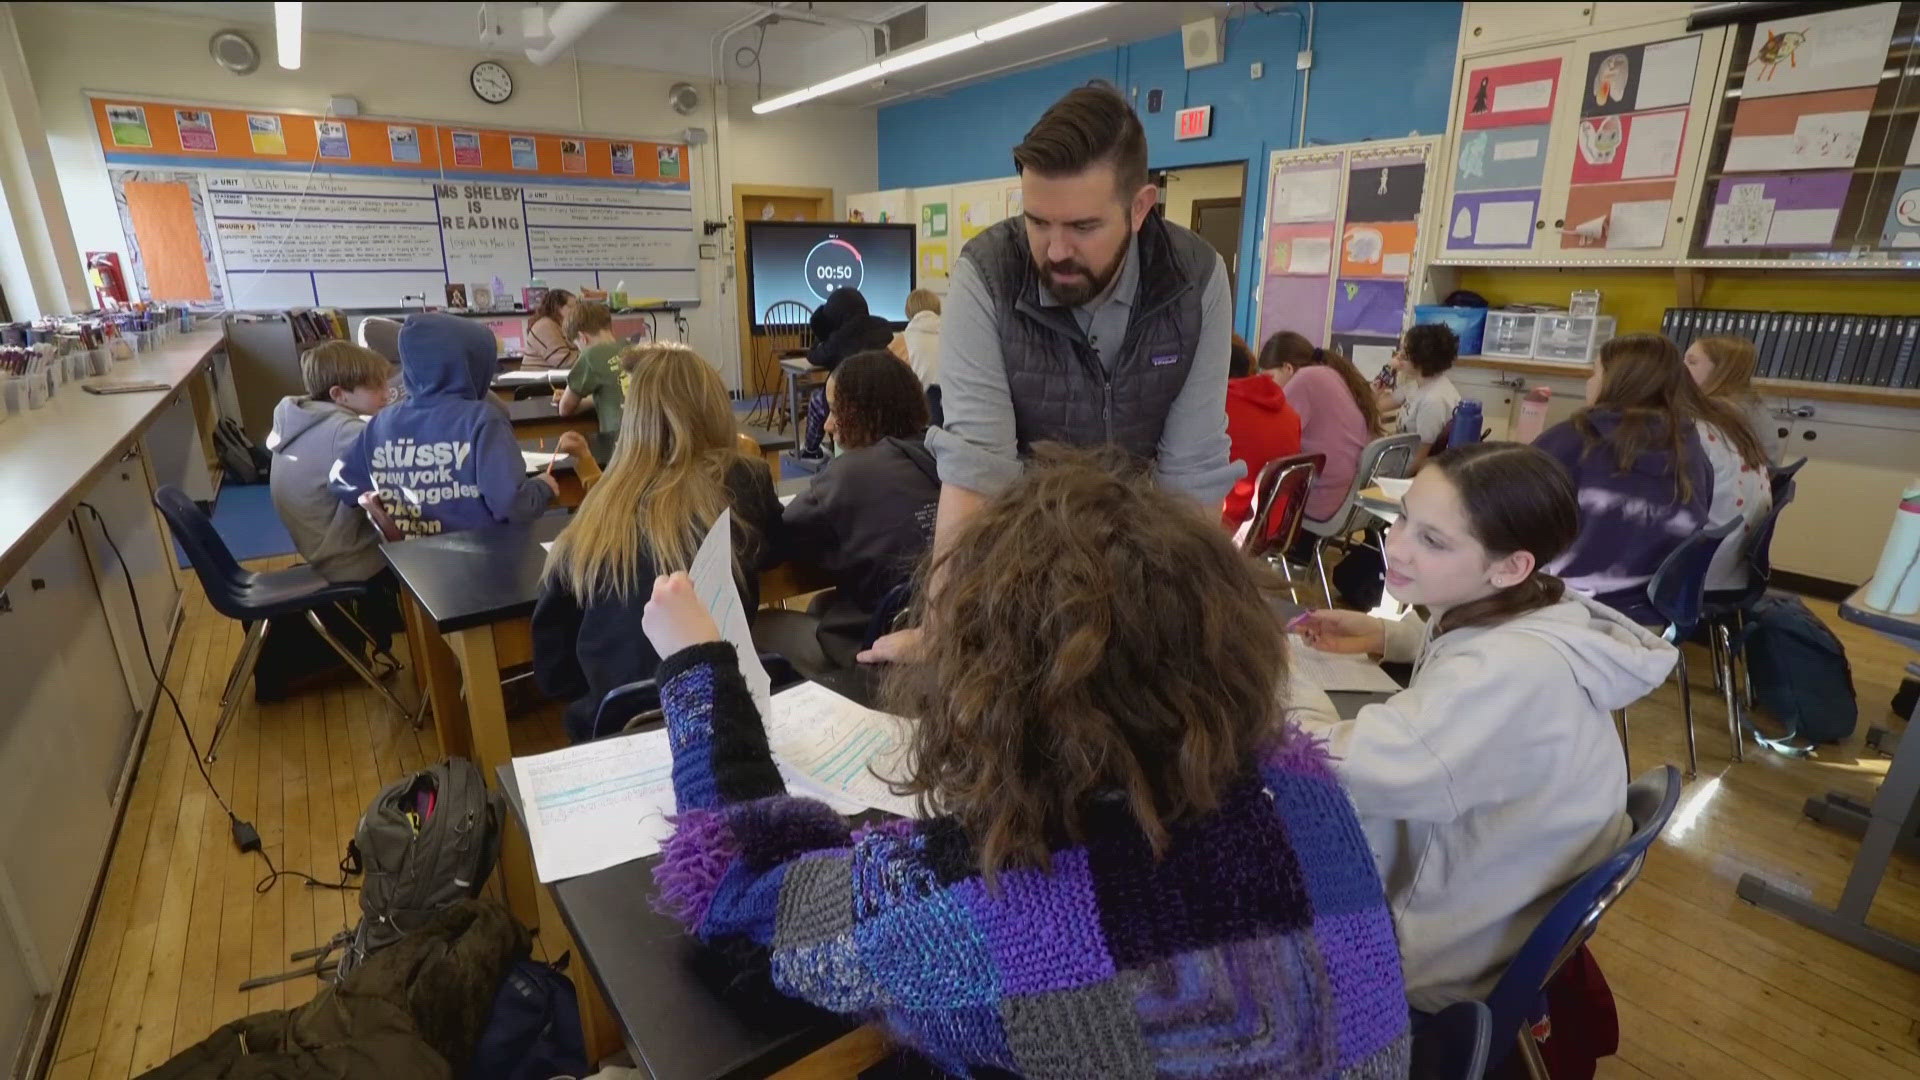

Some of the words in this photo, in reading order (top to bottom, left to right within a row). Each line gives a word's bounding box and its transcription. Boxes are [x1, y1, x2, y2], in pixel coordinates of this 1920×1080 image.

[1181, 110, 1204, 136] EXIT
[220, 178, 239, 186] UNIT
[437, 184, 458, 199] MS
[464, 185, 519, 201] SHELBY
[467, 201, 482, 214] IS
[442, 215, 519, 230] READING
[817, 266, 852, 279] 00:50
[371, 438, 471, 470] stüssy
[408, 464, 454, 488] york
[378, 487, 400, 500] os
[395, 519, 442, 534] ndon
